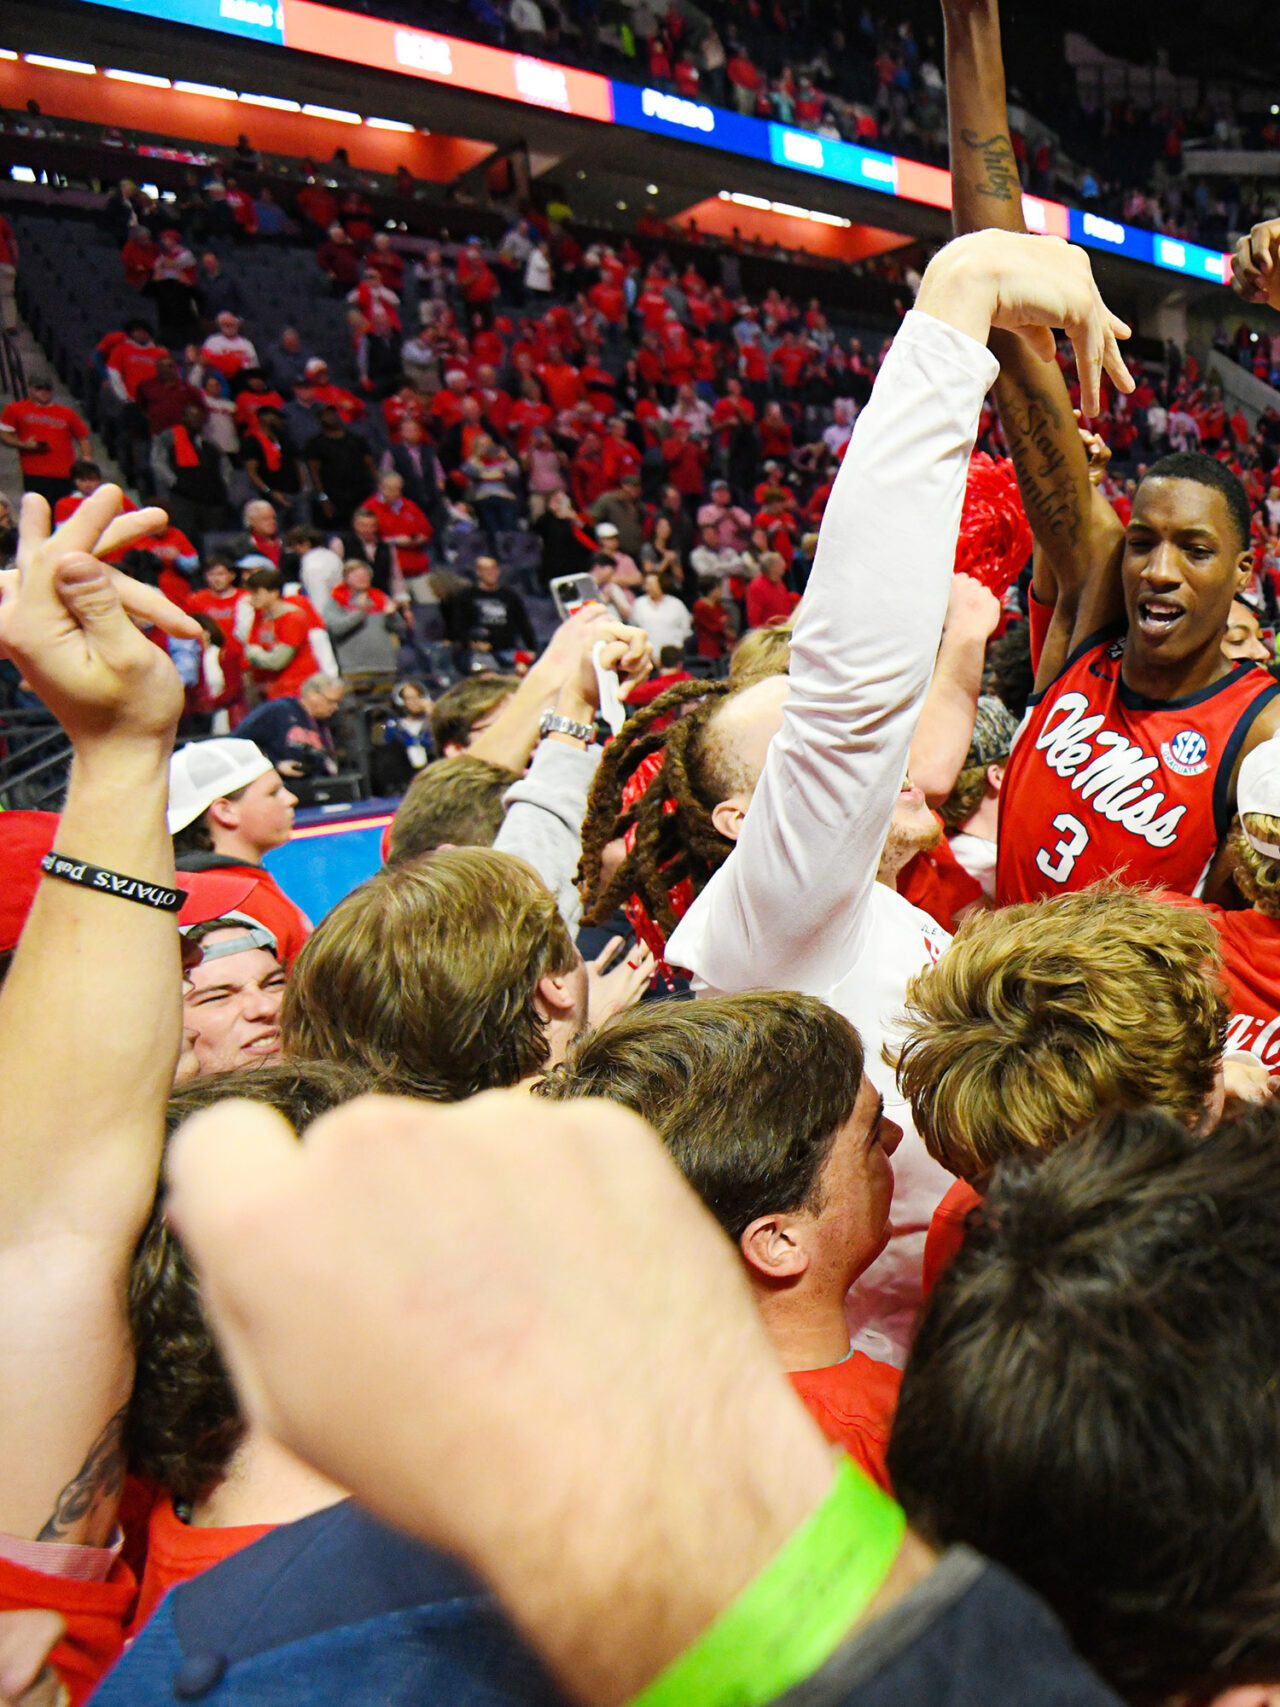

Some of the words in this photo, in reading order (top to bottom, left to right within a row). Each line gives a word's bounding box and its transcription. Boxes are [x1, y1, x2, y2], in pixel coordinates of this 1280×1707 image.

[1034, 691, 1106, 778] Ole
[1071, 730, 1187, 848] Miss
[1162, 750, 1198, 774] GRADUATE
[1171, 730, 1207, 765] SEC
[1035, 813, 1091, 883] 3
